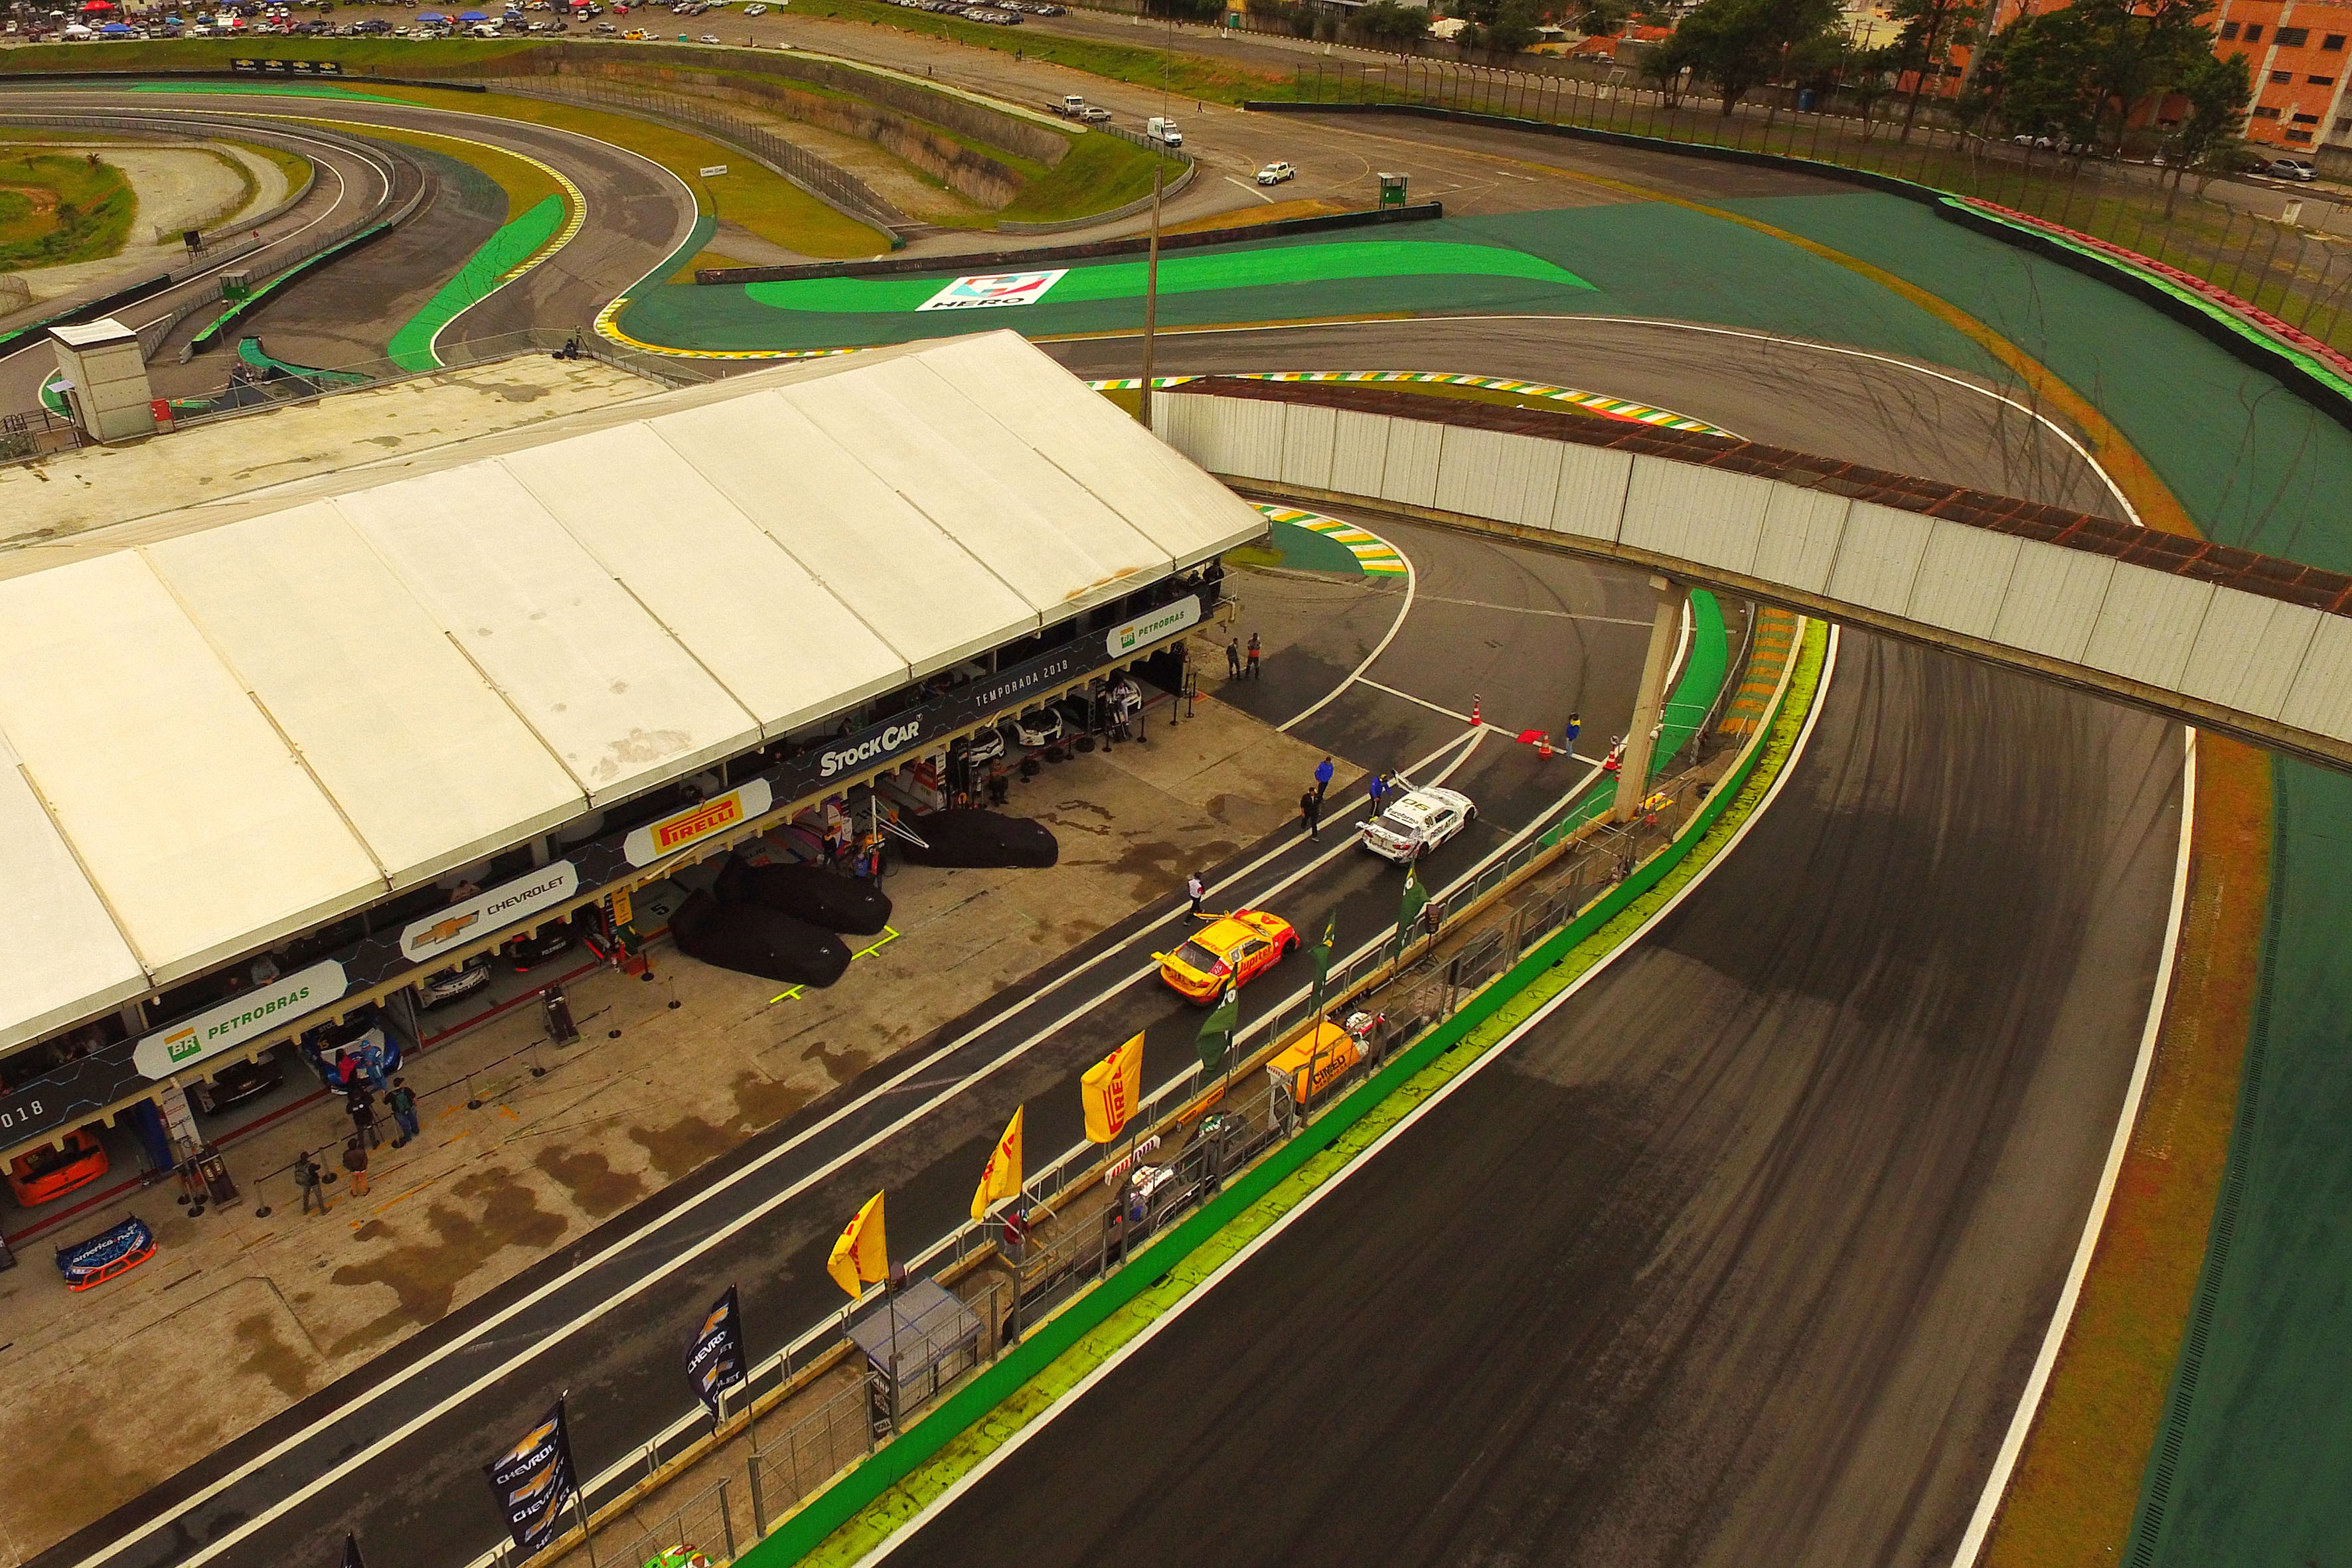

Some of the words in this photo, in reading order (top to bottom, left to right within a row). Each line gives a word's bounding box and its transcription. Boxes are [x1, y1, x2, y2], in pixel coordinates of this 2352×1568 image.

[932, 297, 1024, 308] HERO
[1138, 611, 1184, 637] PETROBRAS
[976, 672, 1038, 706] TEMPORADA
[1044, 659, 1067, 678] 2018
[659, 800, 734, 846] PIRELLI
[487, 876, 564, 915] CHEVROLET
[1238, 945, 1272, 975] Jupiter
[208, 986, 309, 1040] PETROBRAS
[1314, 1055, 1346, 1085] CIMED
